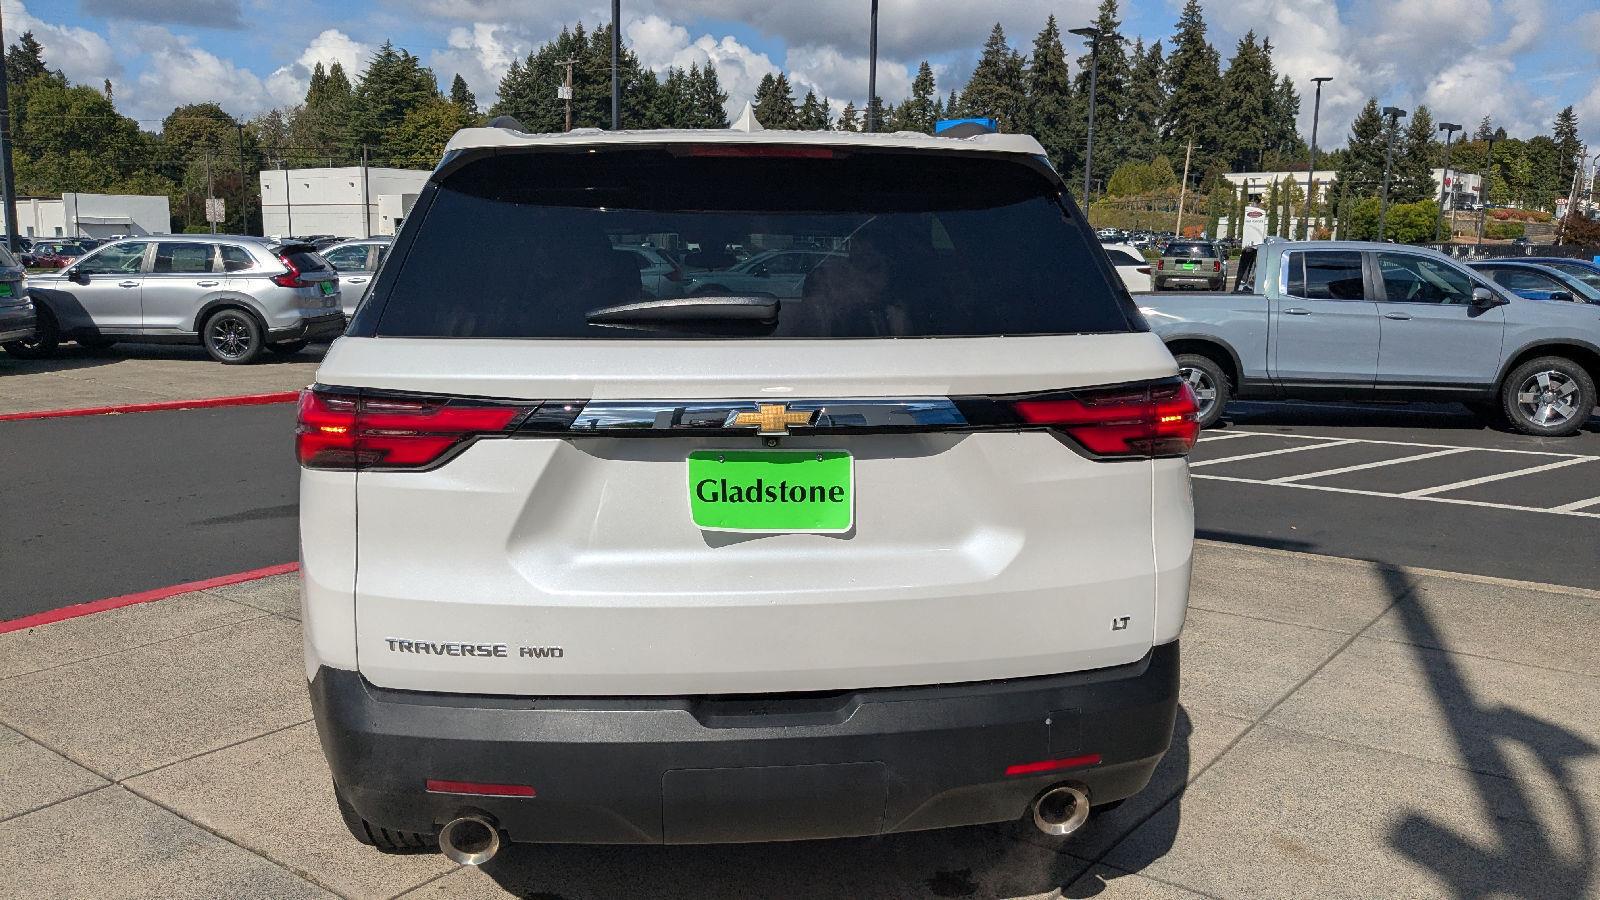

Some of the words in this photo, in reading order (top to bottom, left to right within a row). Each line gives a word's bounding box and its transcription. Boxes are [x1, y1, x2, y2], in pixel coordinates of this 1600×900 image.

[696, 478, 845, 503] Gladstone
[1112, 616, 1131, 631] LT
[385, 636, 508, 658] TRAVERSE
[519, 645, 564, 659] AWD
